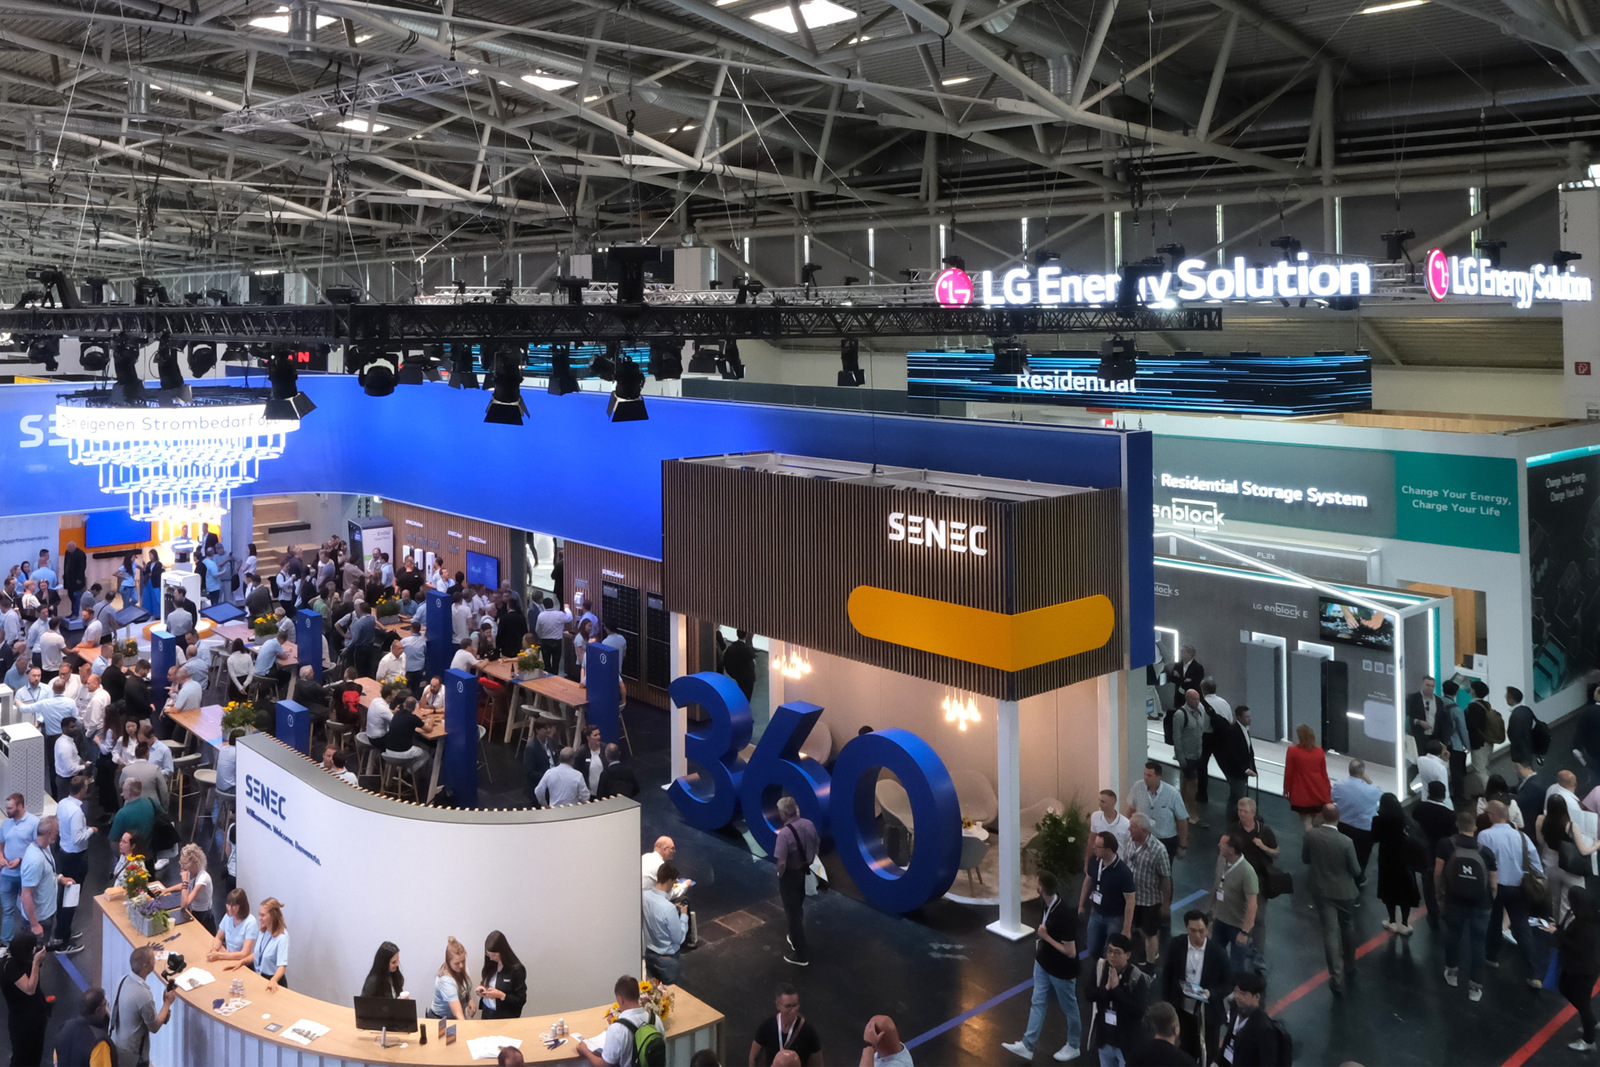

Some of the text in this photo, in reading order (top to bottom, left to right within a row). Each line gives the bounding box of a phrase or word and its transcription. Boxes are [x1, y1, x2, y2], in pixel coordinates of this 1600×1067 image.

[982, 252, 1371, 308] LG Enery Solution
[1452, 256, 1592, 309] LG Energy Solution
[1016, 370, 1137, 393] Residential
[80, 416, 135, 433] eigenen
[142, 413, 254, 431] Strombedarf
[1161, 473, 1368, 507] Residential Storage System
[1401, 485, 1512, 506] Change Your Energy,
[1153, 500, 1225, 528] enblock
[1412, 499, 1501, 517] Charge Your Life
[889, 512, 987, 556] SENEC
[1174, 588, 1180, 596] S
[1252, 602, 1309, 619] LG enblock E
[245, 774, 286, 821] SENEC
[667, 671, 963, 914] 360
